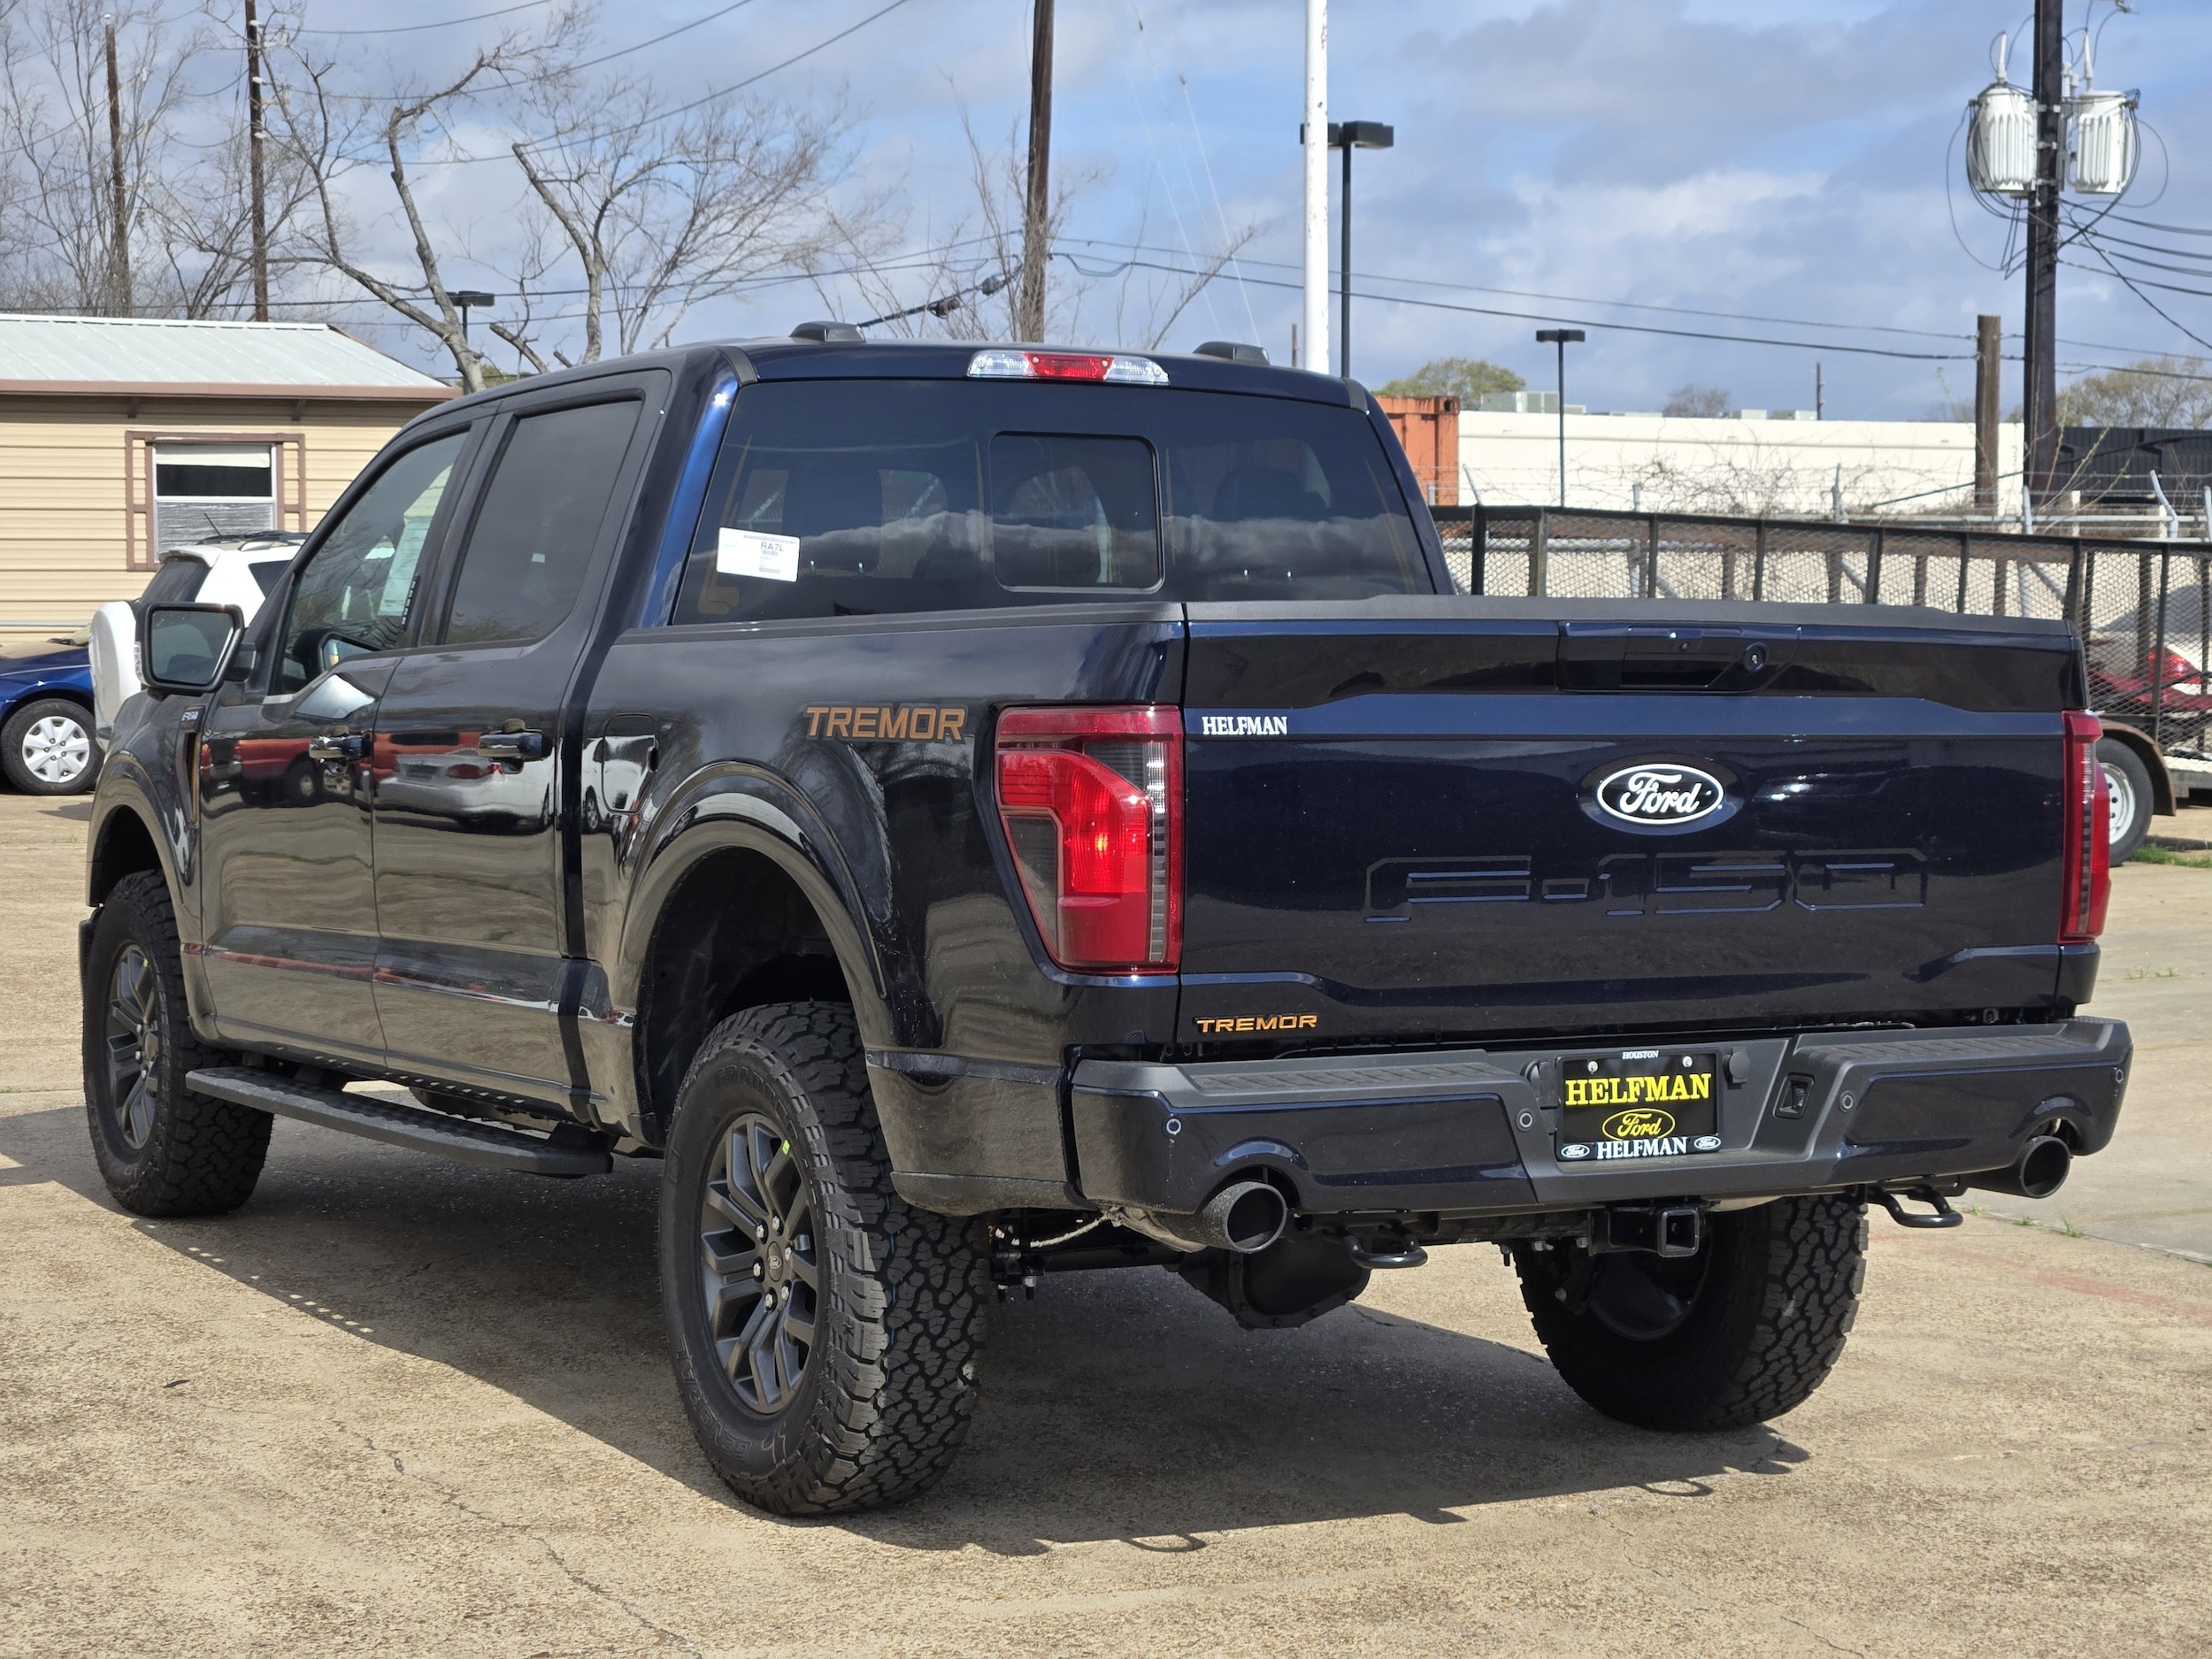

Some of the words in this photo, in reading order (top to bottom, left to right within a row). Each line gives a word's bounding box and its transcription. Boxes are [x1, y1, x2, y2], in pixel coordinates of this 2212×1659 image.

[760, 541, 784, 552] RA7L
[806, 706, 966, 741] TREMOR
[1202, 716, 1287, 735] HELFMAN
[1619, 772, 1702, 813] Ford
[1196, 1014, 1318, 1033] TREMOR
[1622, 1049, 1660, 1060] HOUSTON
[1565, 1073, 1712, 1105] HELFMAN
[1617, 1112, 1663, 1137] Ford
[1596, 1136, 1688, 1160] HELFMAN
